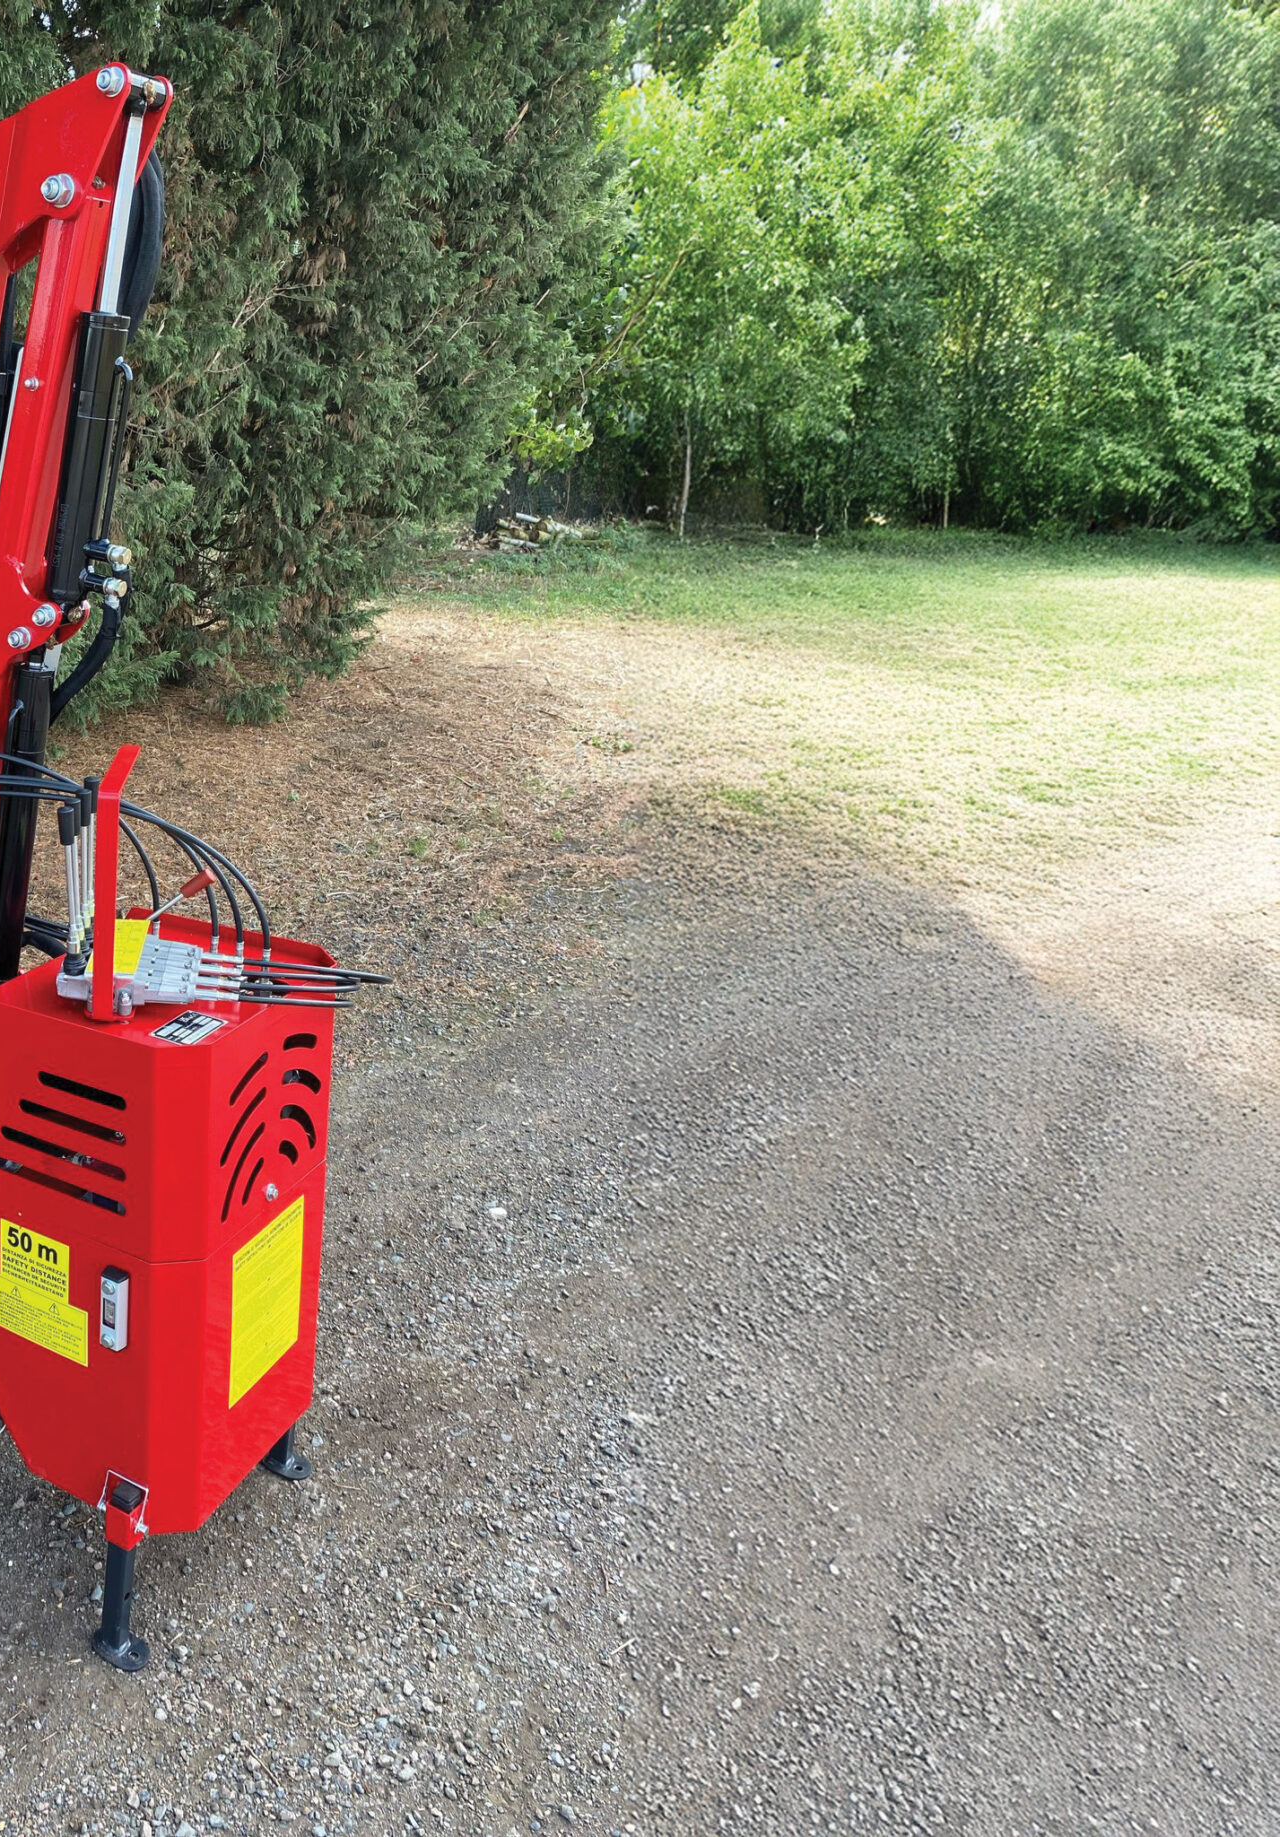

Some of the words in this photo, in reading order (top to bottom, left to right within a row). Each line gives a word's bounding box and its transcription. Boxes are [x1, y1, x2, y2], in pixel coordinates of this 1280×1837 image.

[2, 1247, 27, 1261] DISTANZA
[7, 1226, 32, 1253] 50
[38, 1243, 58, 1265] m
[2, 1254, 28, 1269] SAFETY
[31, 1267, 66, 1286] DISTANCE
